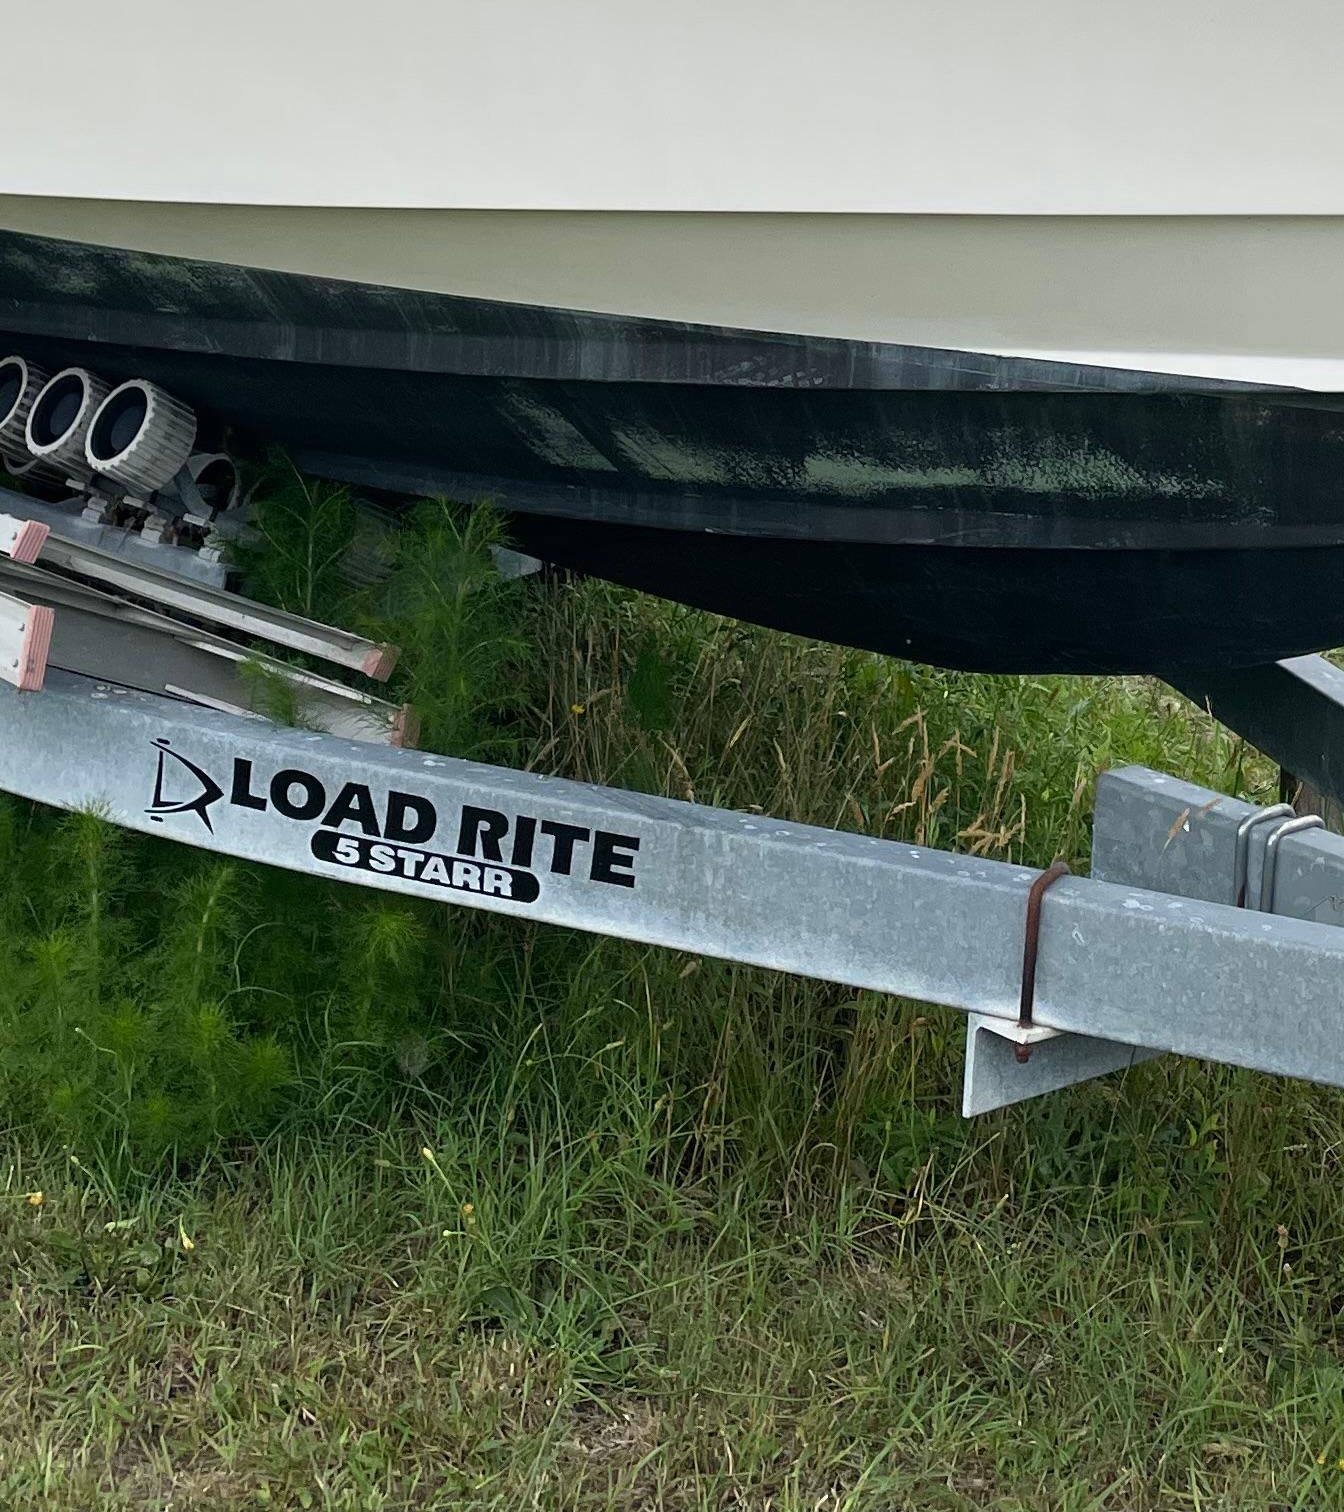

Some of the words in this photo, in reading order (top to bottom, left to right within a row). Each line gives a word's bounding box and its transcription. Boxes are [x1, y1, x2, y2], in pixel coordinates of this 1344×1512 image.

[230, 757, 437, 844] LOAD
[456, 804, 641, 889] RITE
[332, 836, 361, 865] 5
[368, 845, 514, 898] STARR
